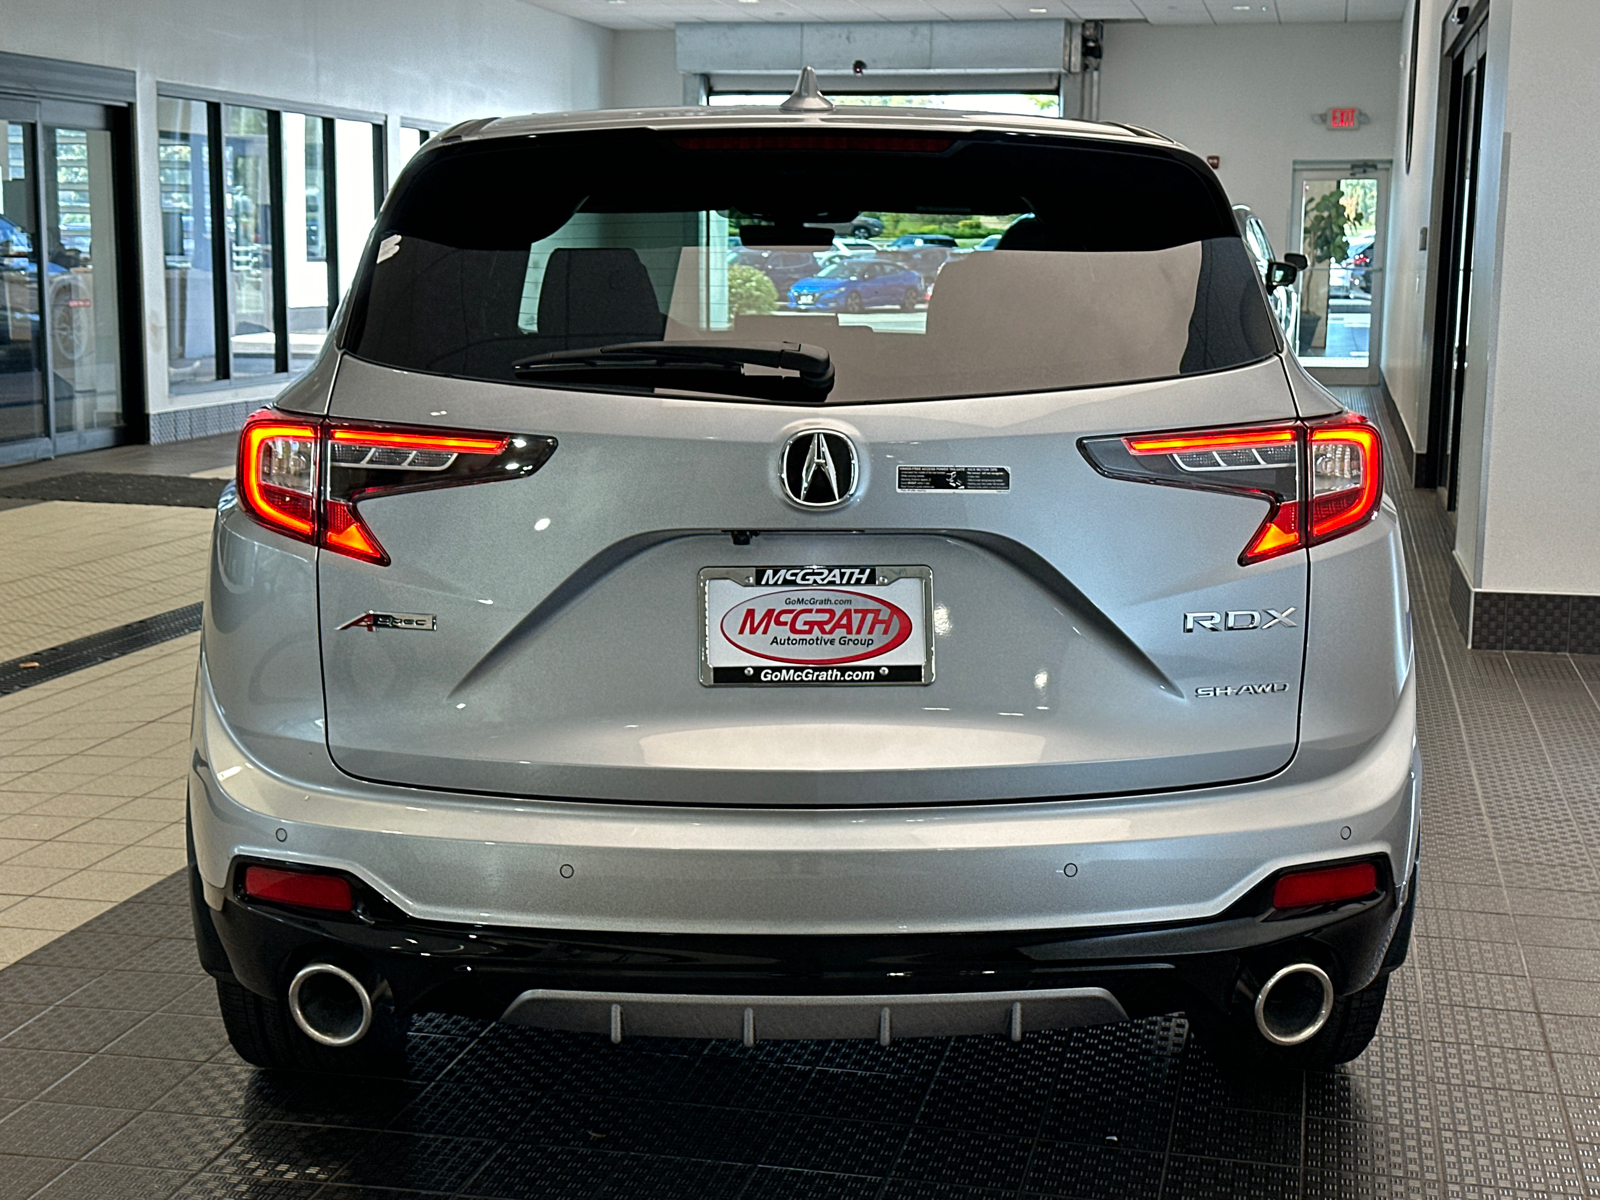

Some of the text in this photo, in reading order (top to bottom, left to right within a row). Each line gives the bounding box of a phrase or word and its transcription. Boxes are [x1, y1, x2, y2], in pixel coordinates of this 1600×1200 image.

[1331, 108, 1356, 127] EXIT
[784, 597, 853, 606] GoMcGrath.com
[1182, 606, 1298, 633] RDX
[769, 636, 875, 648] Automotive Group
[760, 669, 876, 682] GoMcGrath.com
[1194, 682, 1291, 698] SH-AWD
